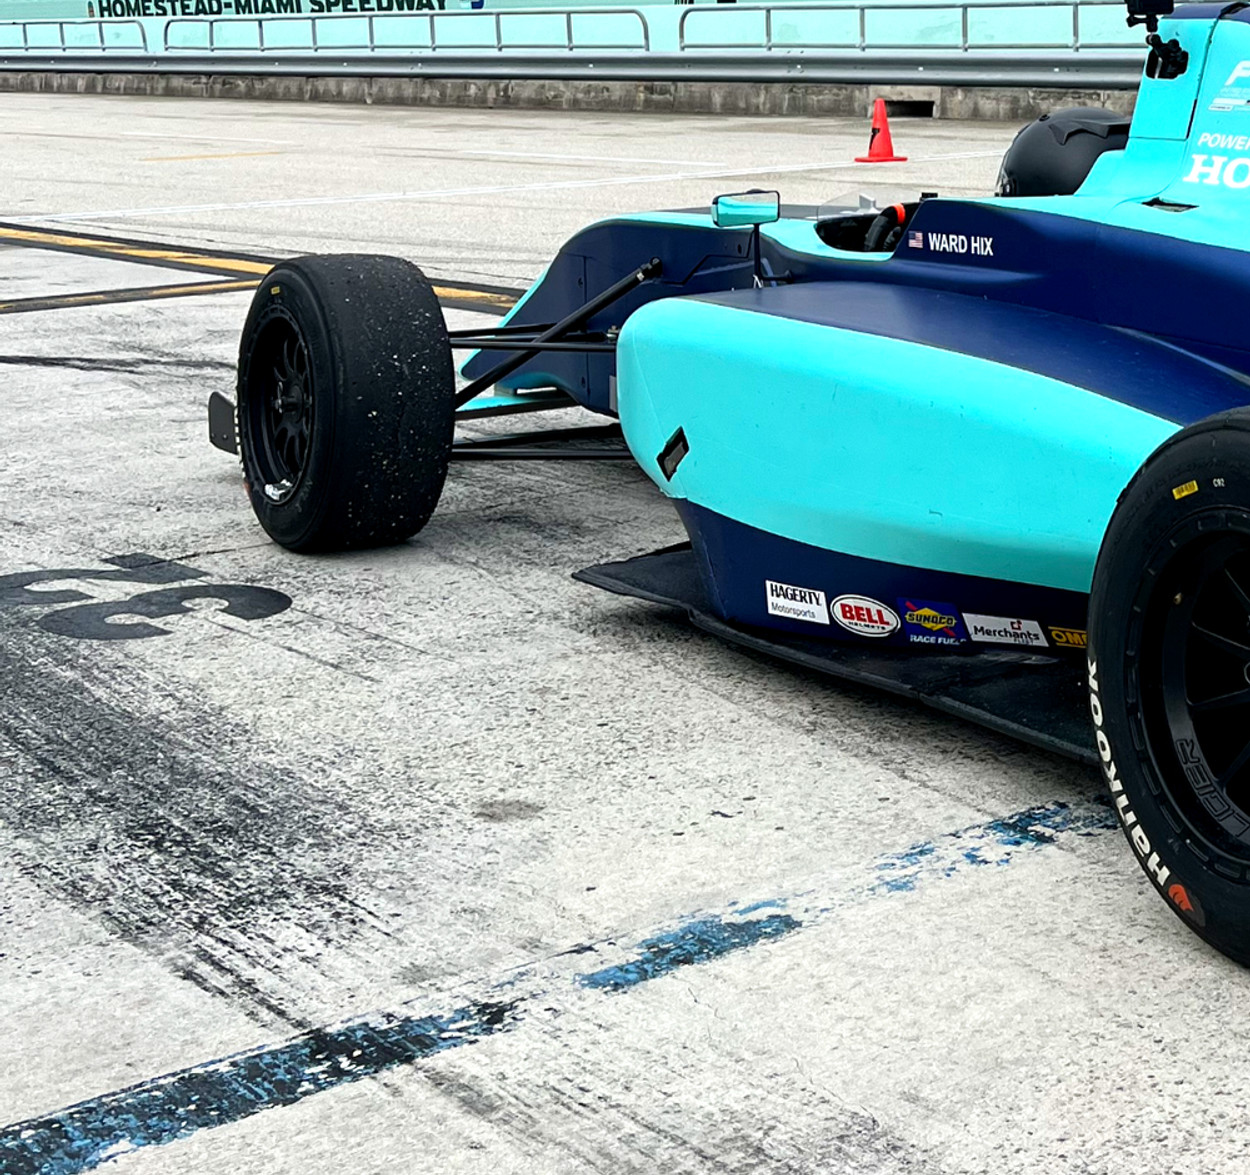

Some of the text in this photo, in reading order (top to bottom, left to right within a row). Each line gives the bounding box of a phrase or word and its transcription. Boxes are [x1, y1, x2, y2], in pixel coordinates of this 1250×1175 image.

[928, 232, 994, 256] WARD HIX
[770, 583, 822, 606] HAGERTY
[771, 602, 816, 619] Motorsports
[840, 603, 890, 626] BELL
[907, 612, 955, 626] SUNOCO
[910, 635, 936, 644] RACE
[973, 625, 1040, 641] Merchants
